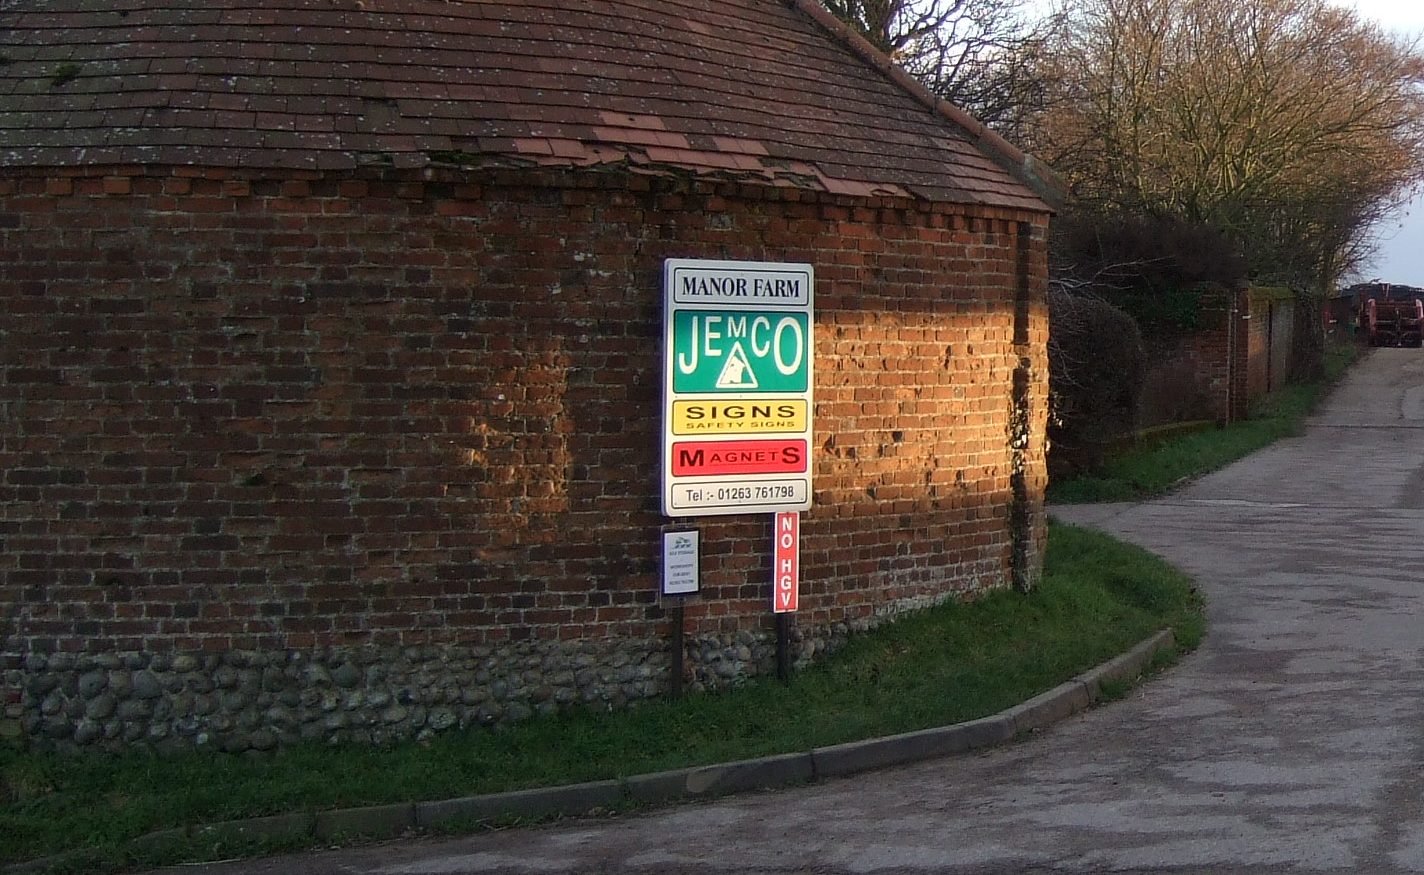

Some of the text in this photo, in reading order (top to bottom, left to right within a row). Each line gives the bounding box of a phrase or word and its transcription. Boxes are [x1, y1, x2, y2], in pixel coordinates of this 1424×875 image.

[682, 276, 800, 298] MANOR FARM
[678, 315, 803, 376] JEMCO
[686, 405, 796, 420] SIGNS
[686, 421, 744, 429] SAFETY
[685, 489, 703, 501] Tel
[717, 488, 751, 500] 01263
[755, 486, 795, 499] 761798
[780, 517, 793, 607] NO HGV
